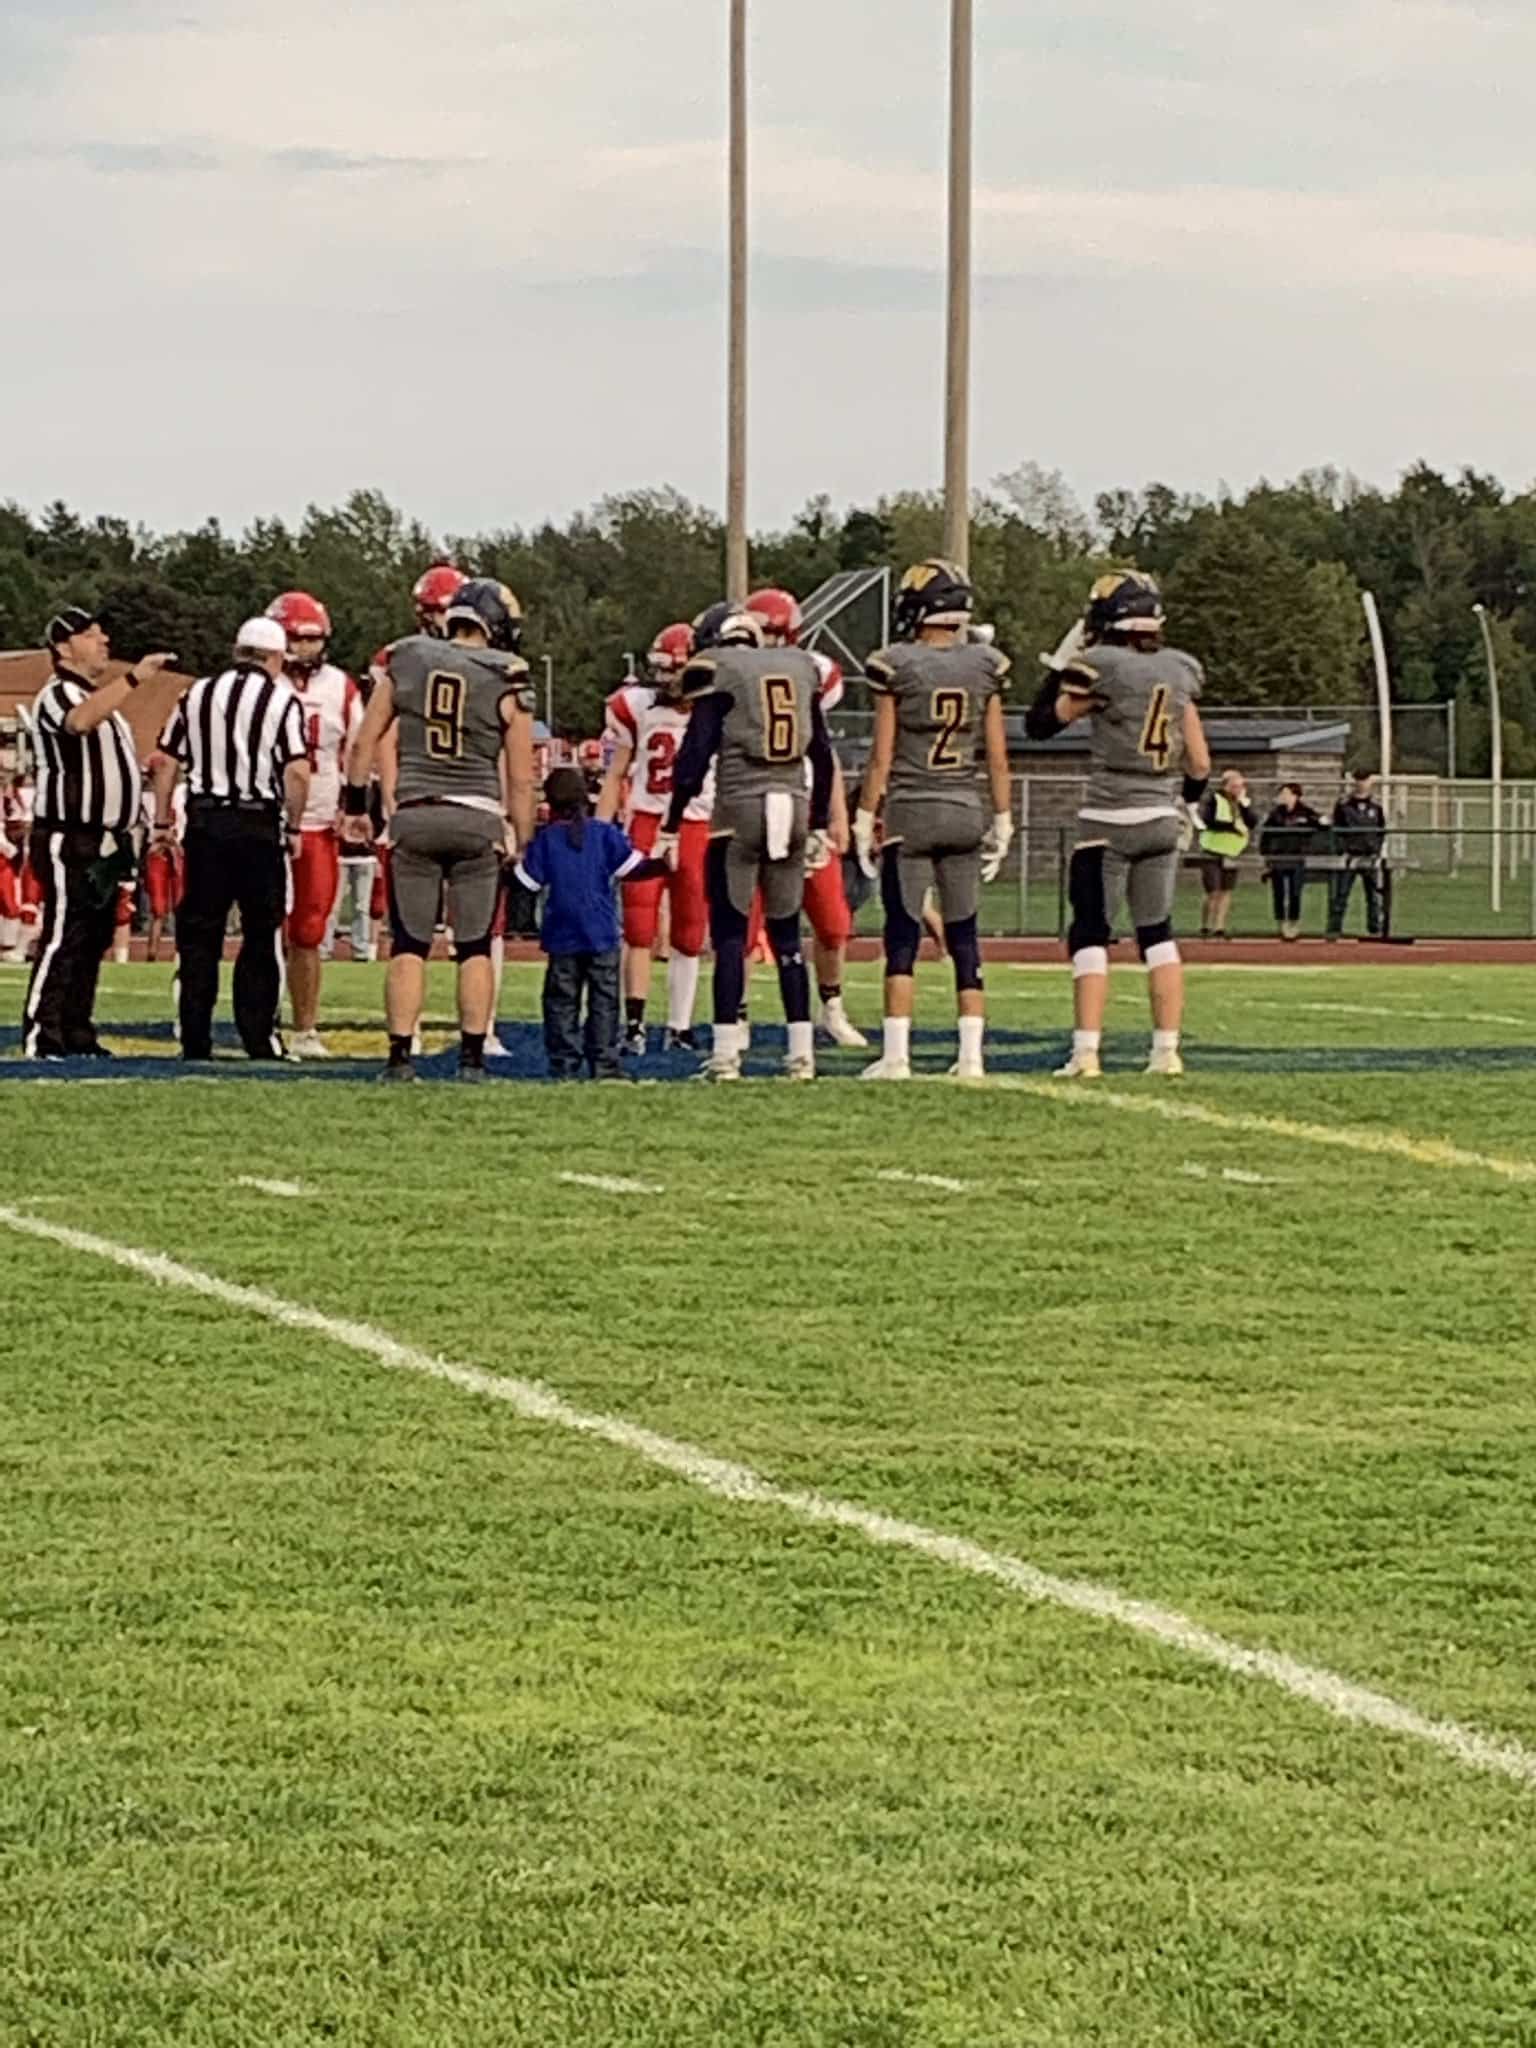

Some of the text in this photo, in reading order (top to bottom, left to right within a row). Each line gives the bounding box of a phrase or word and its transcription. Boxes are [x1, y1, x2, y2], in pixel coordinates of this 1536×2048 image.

[425, 669, 466, 758] 9
[759, 673, 797, 762] 6
[927, 687, 968, 770] 2
[1138, 682, 1171, 770] 4
